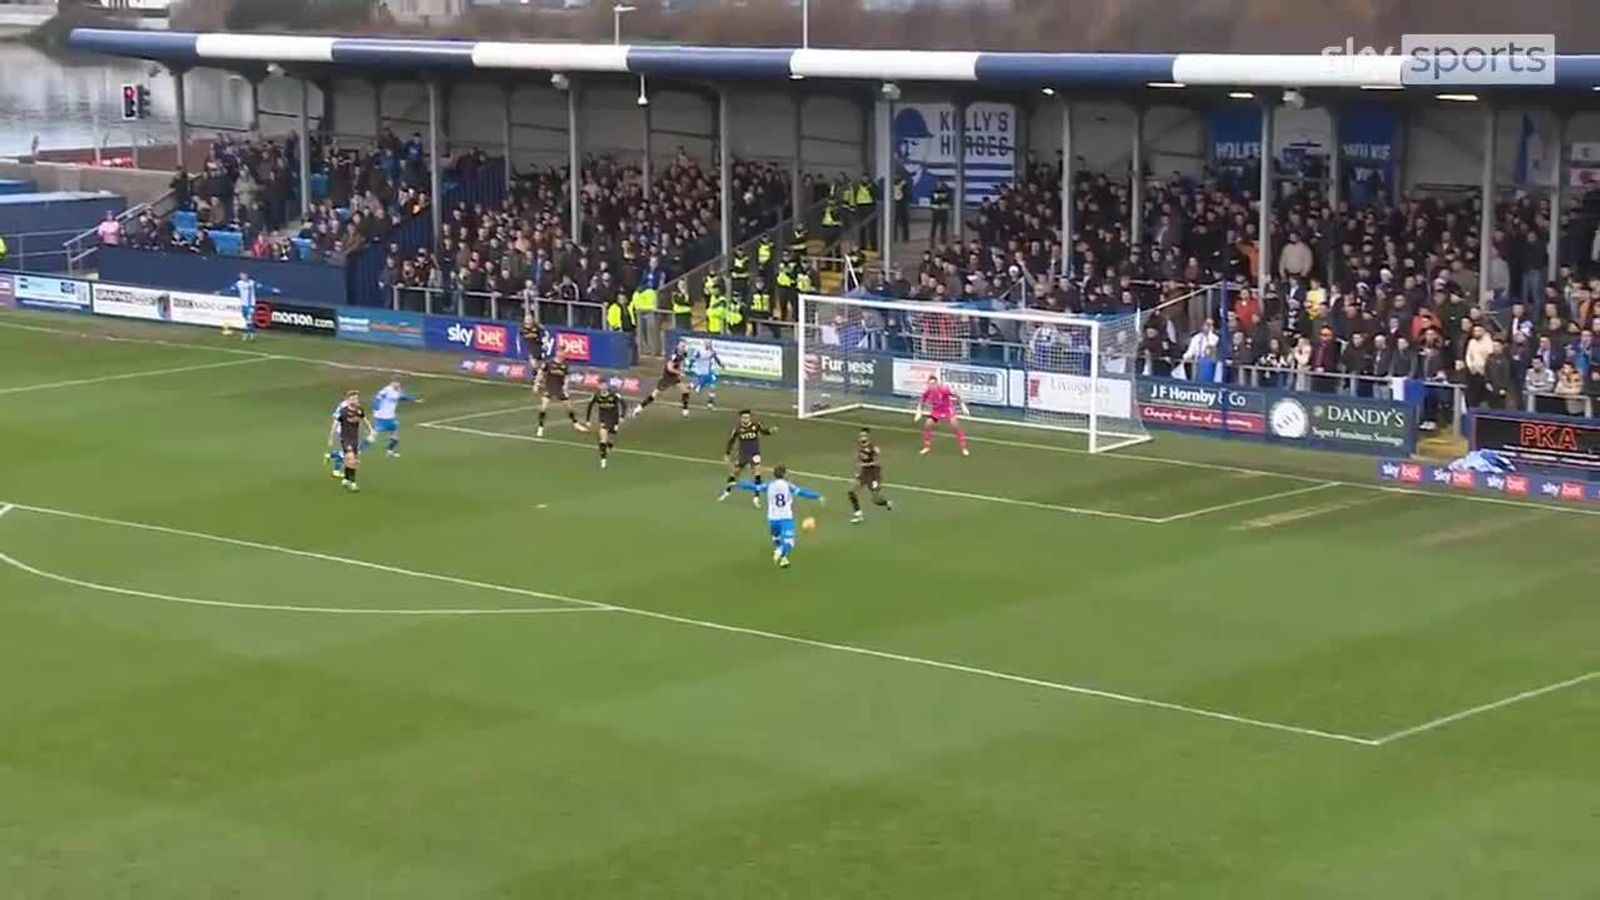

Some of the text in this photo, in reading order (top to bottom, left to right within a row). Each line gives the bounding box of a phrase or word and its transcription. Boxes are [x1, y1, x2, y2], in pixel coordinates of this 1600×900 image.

[272, 310, 335, 328] morson.com
[447, 324, 474, 347] sky
[478, 327, 503, 347] bet
[1151, 384, 1158, 398] J
[1160, 385, 1168, 398] F
[1170, 386, 1216, 405] Hornby
[1228, 392, 1247, 407] Co
[1328, 405, 1405, 428] DANDY'S
[1520, 422, 1578, 450] PKA
[1382, 462, 1399, 478] sky
[1434, 468, 1450, 483] sky
[1487, 475, 1504, 490] sky
[1543, 482, 1559, 497] sky
[775, 493, 786, 508] 8
